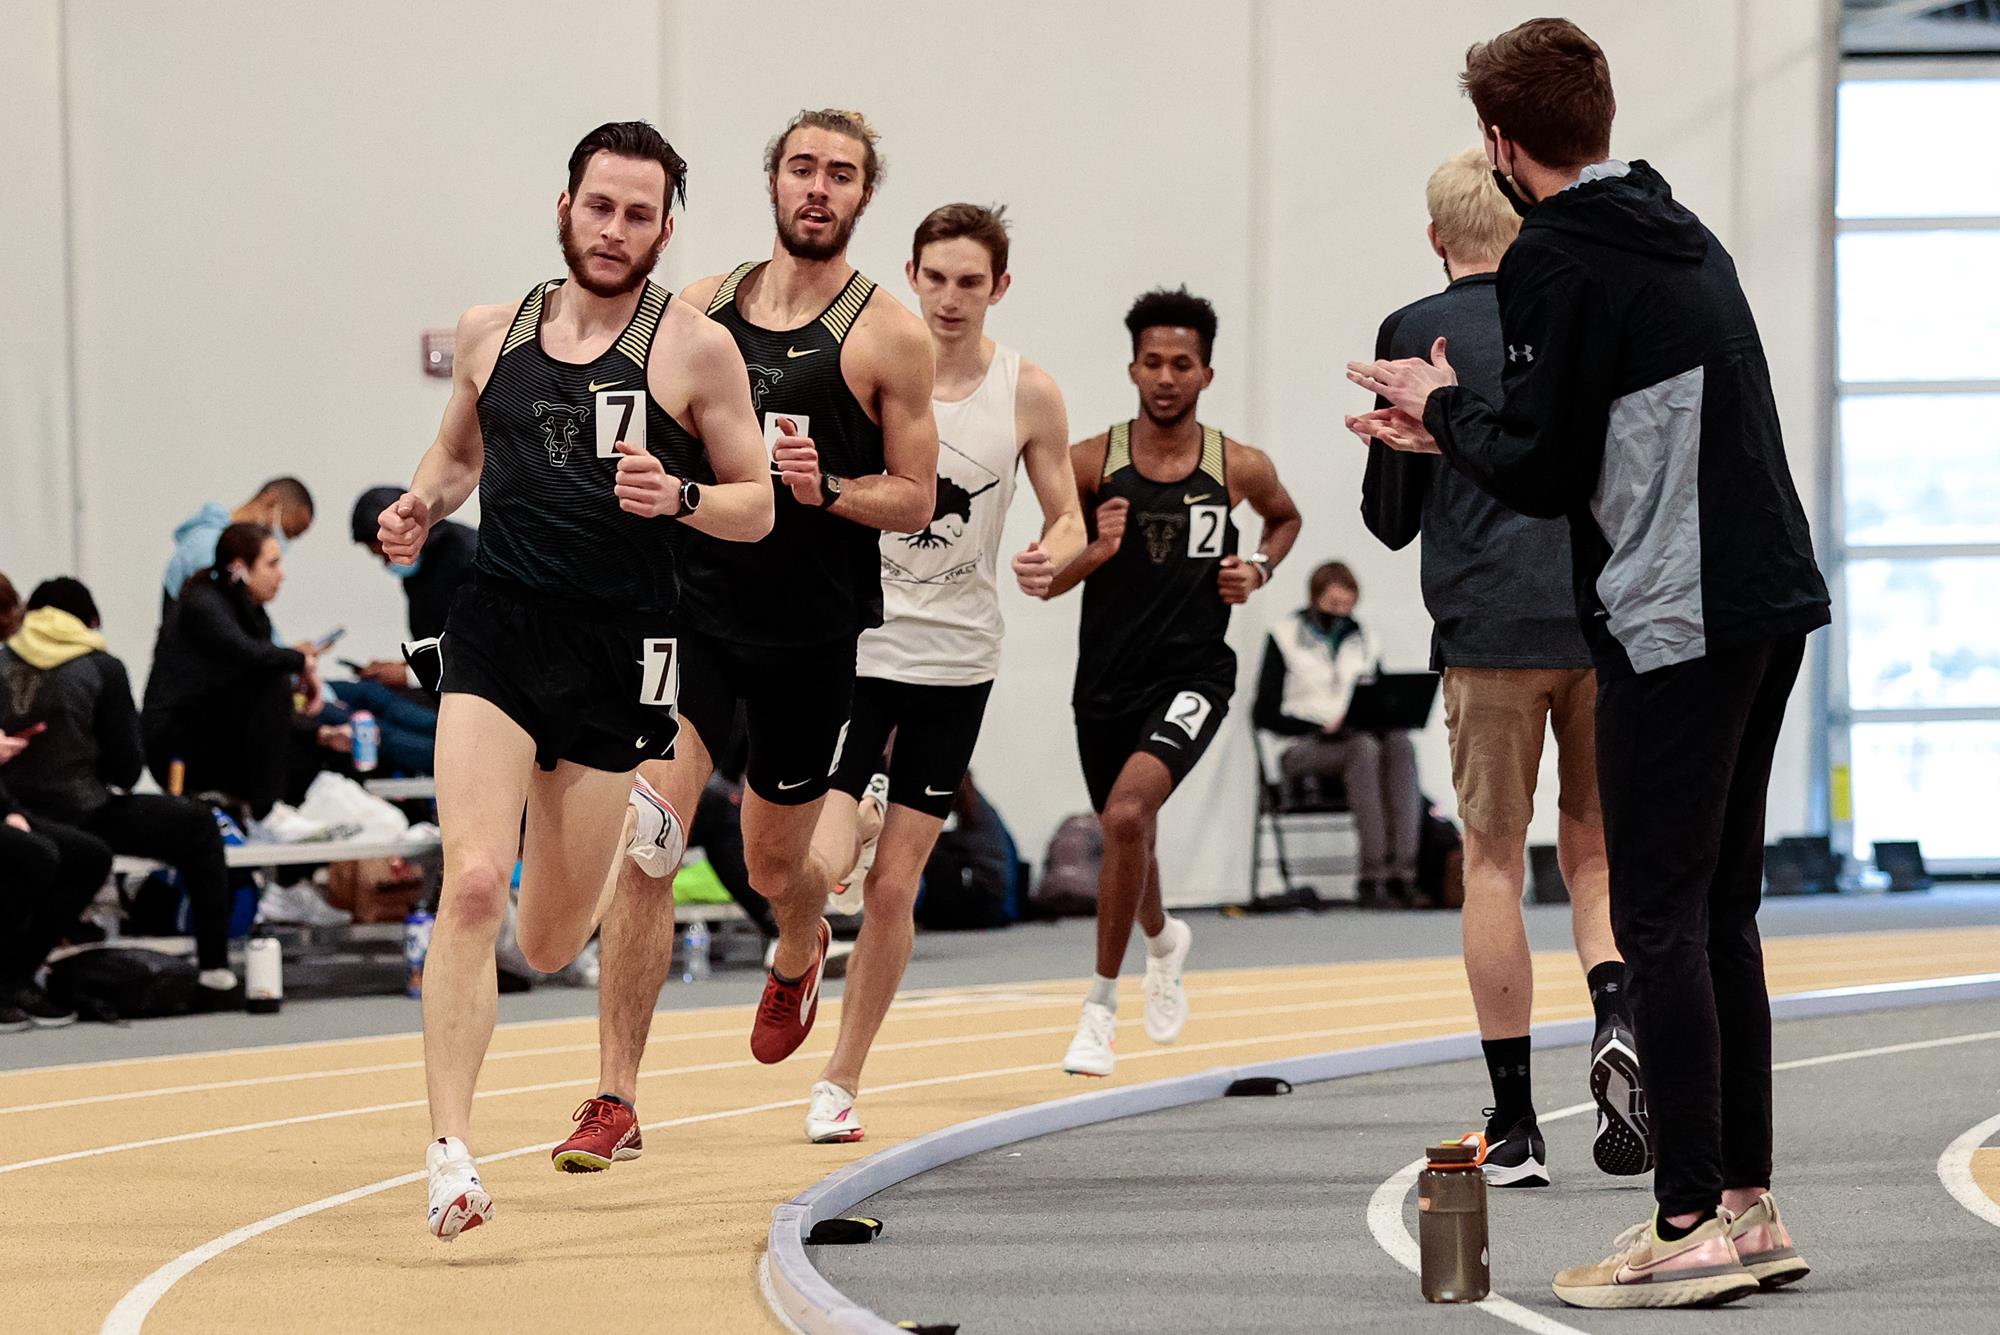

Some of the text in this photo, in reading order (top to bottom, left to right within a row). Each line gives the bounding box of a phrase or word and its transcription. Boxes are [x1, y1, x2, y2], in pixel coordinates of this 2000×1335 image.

[606, 395, 635, 454] 7
[1197, 511, 1218, 553] 2
[653, 643, 673, 701] 7
[1175, 695, 1201, 730] 2
